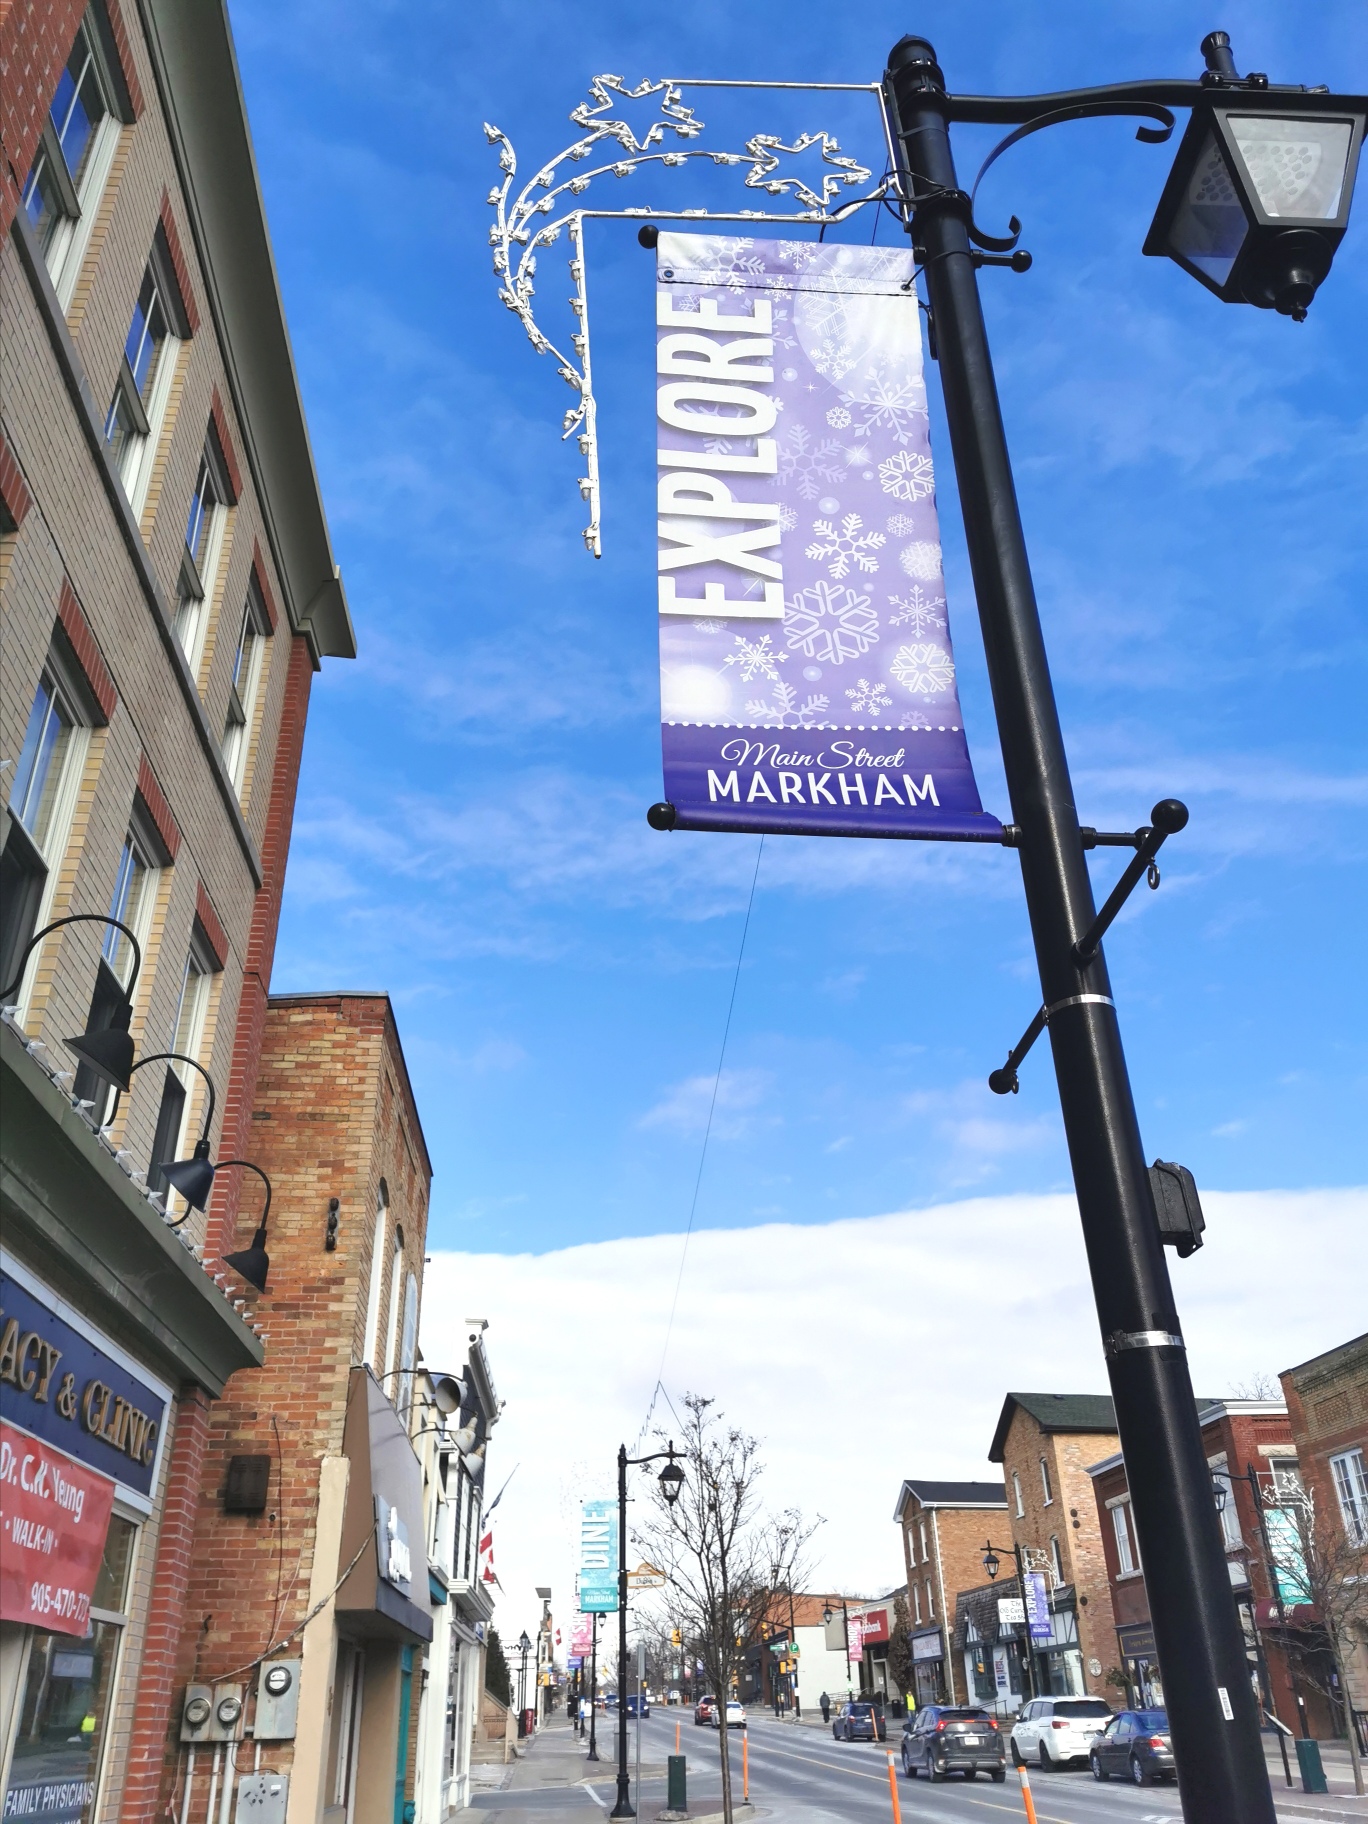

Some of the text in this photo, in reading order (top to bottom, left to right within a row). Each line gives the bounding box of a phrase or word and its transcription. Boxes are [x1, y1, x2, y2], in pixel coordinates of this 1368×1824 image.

[657, 291, 785, 619] EXPLORE
[721, 739, 905, 769] Main Street
[707, 769, 940, 806] MARKHAM
[0, 1317, 157, 1466] ACY & CLINIC
[0, 1441, 17, 1486] Dr.
[52, 1467, 85, 1524] Yeung
[581, 1510, 610, 1569] DINE
[585, 1595, 614, 1603] MARKHAM
[1024, 1580, 1038, 1614] EXPLORE
[848, 1625, 858, 1646] SHOP
[4, 1781, 94, 1817] FAMILY PHYSICIANS
